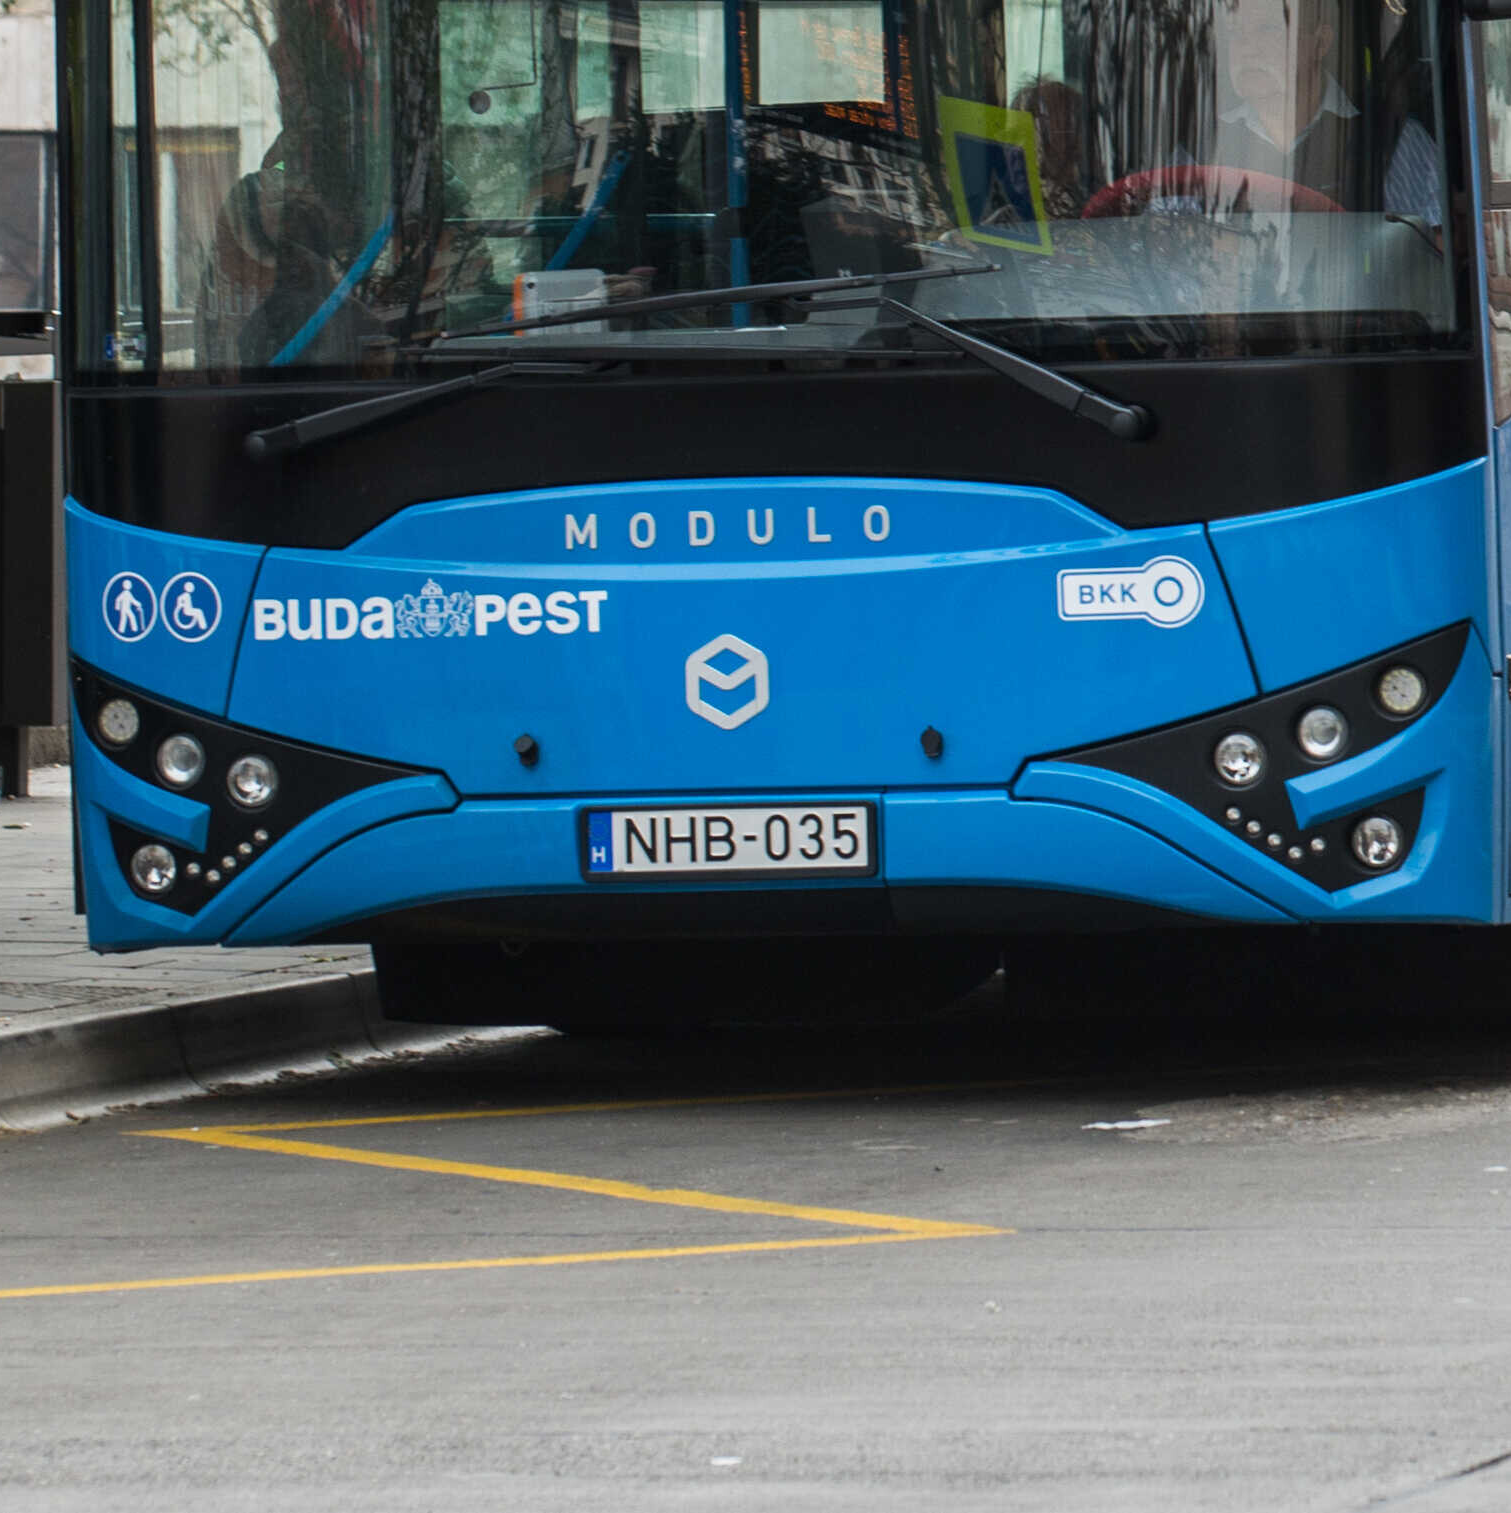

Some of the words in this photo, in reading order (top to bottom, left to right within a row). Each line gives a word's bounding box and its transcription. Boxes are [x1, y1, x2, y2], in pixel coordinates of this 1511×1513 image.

[564, 504, 891, 551] MODULO
[1078, 582, 1137, 605] BKK
[591, 846, 607, 864] H
[624, 812, 859, 865] NHB-035
